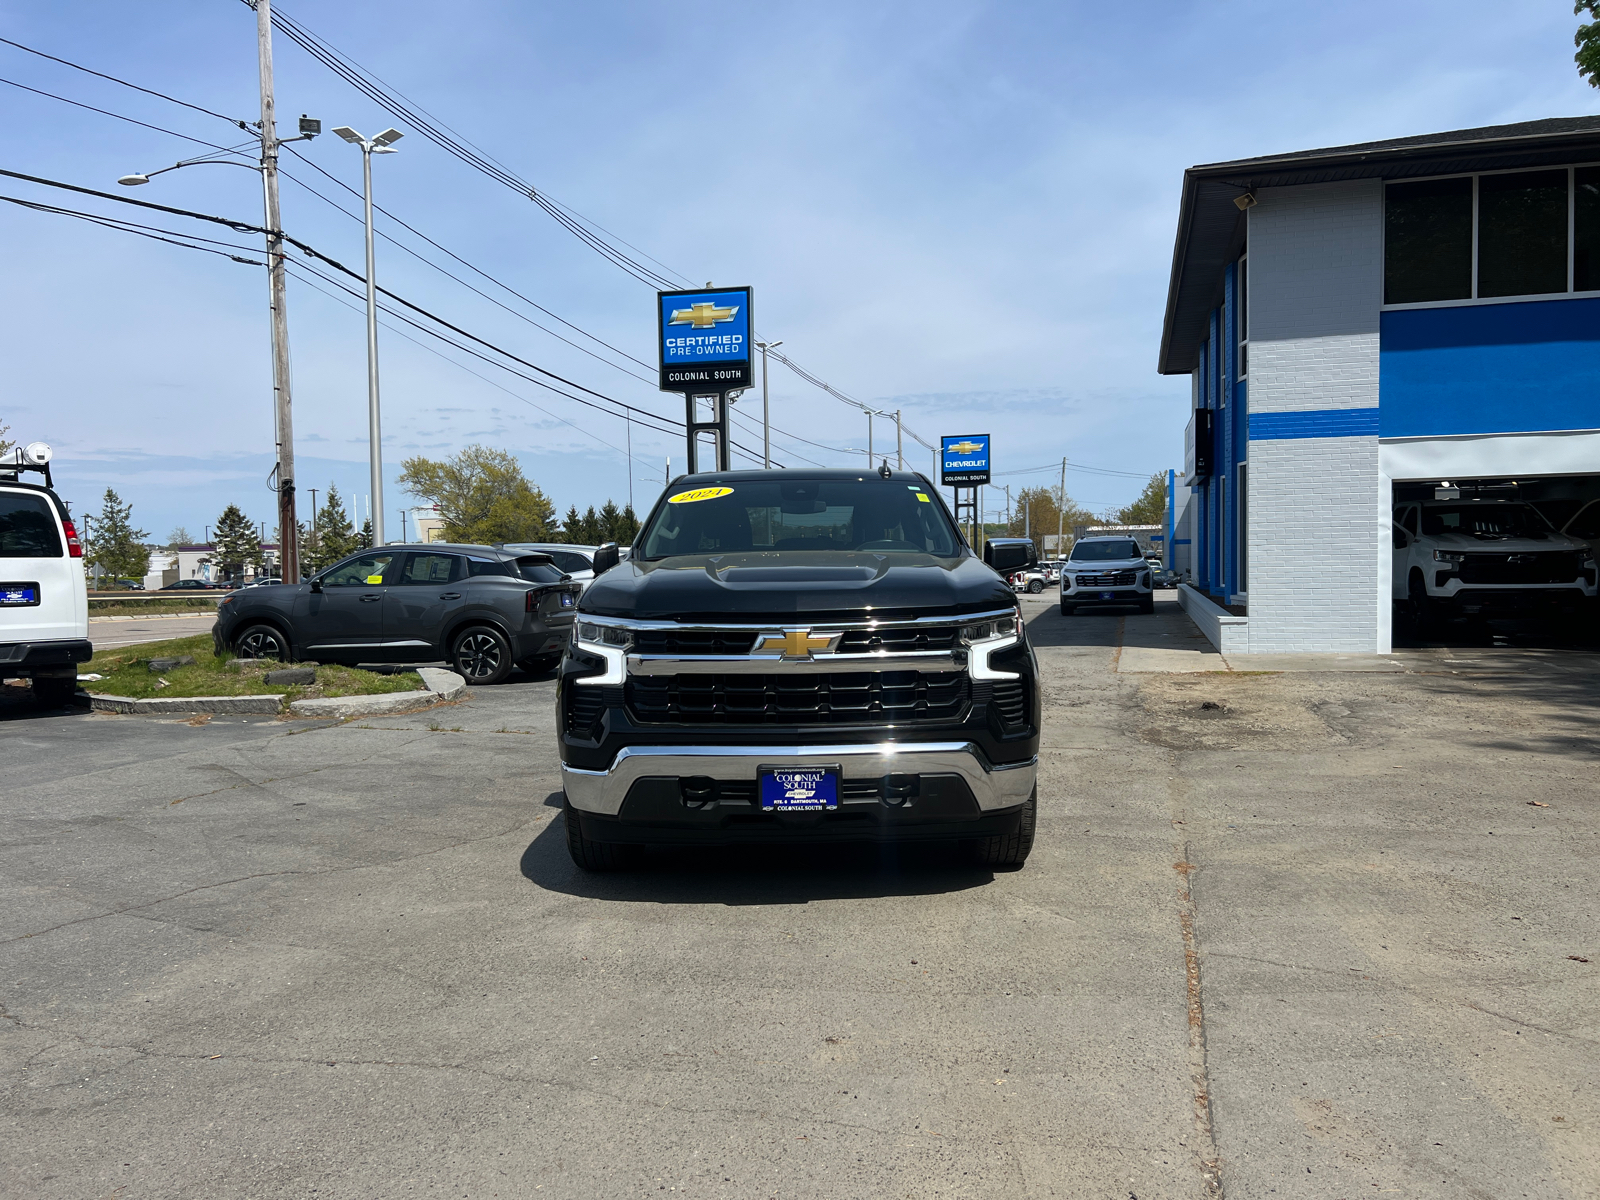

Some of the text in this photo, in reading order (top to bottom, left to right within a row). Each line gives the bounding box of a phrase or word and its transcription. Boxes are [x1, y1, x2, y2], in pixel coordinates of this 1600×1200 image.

[666, 334, 743, 347] CERTIFIED
[670, 344, 739, 356] PRE-OWNED
[669, 370, 741, 381] COLONIAL SOUTH
[945, 460, 986, 468] CHEVROLET
[678, 488, 723, 502] 2024
[776, 774, 823, 782] COLONIAL
